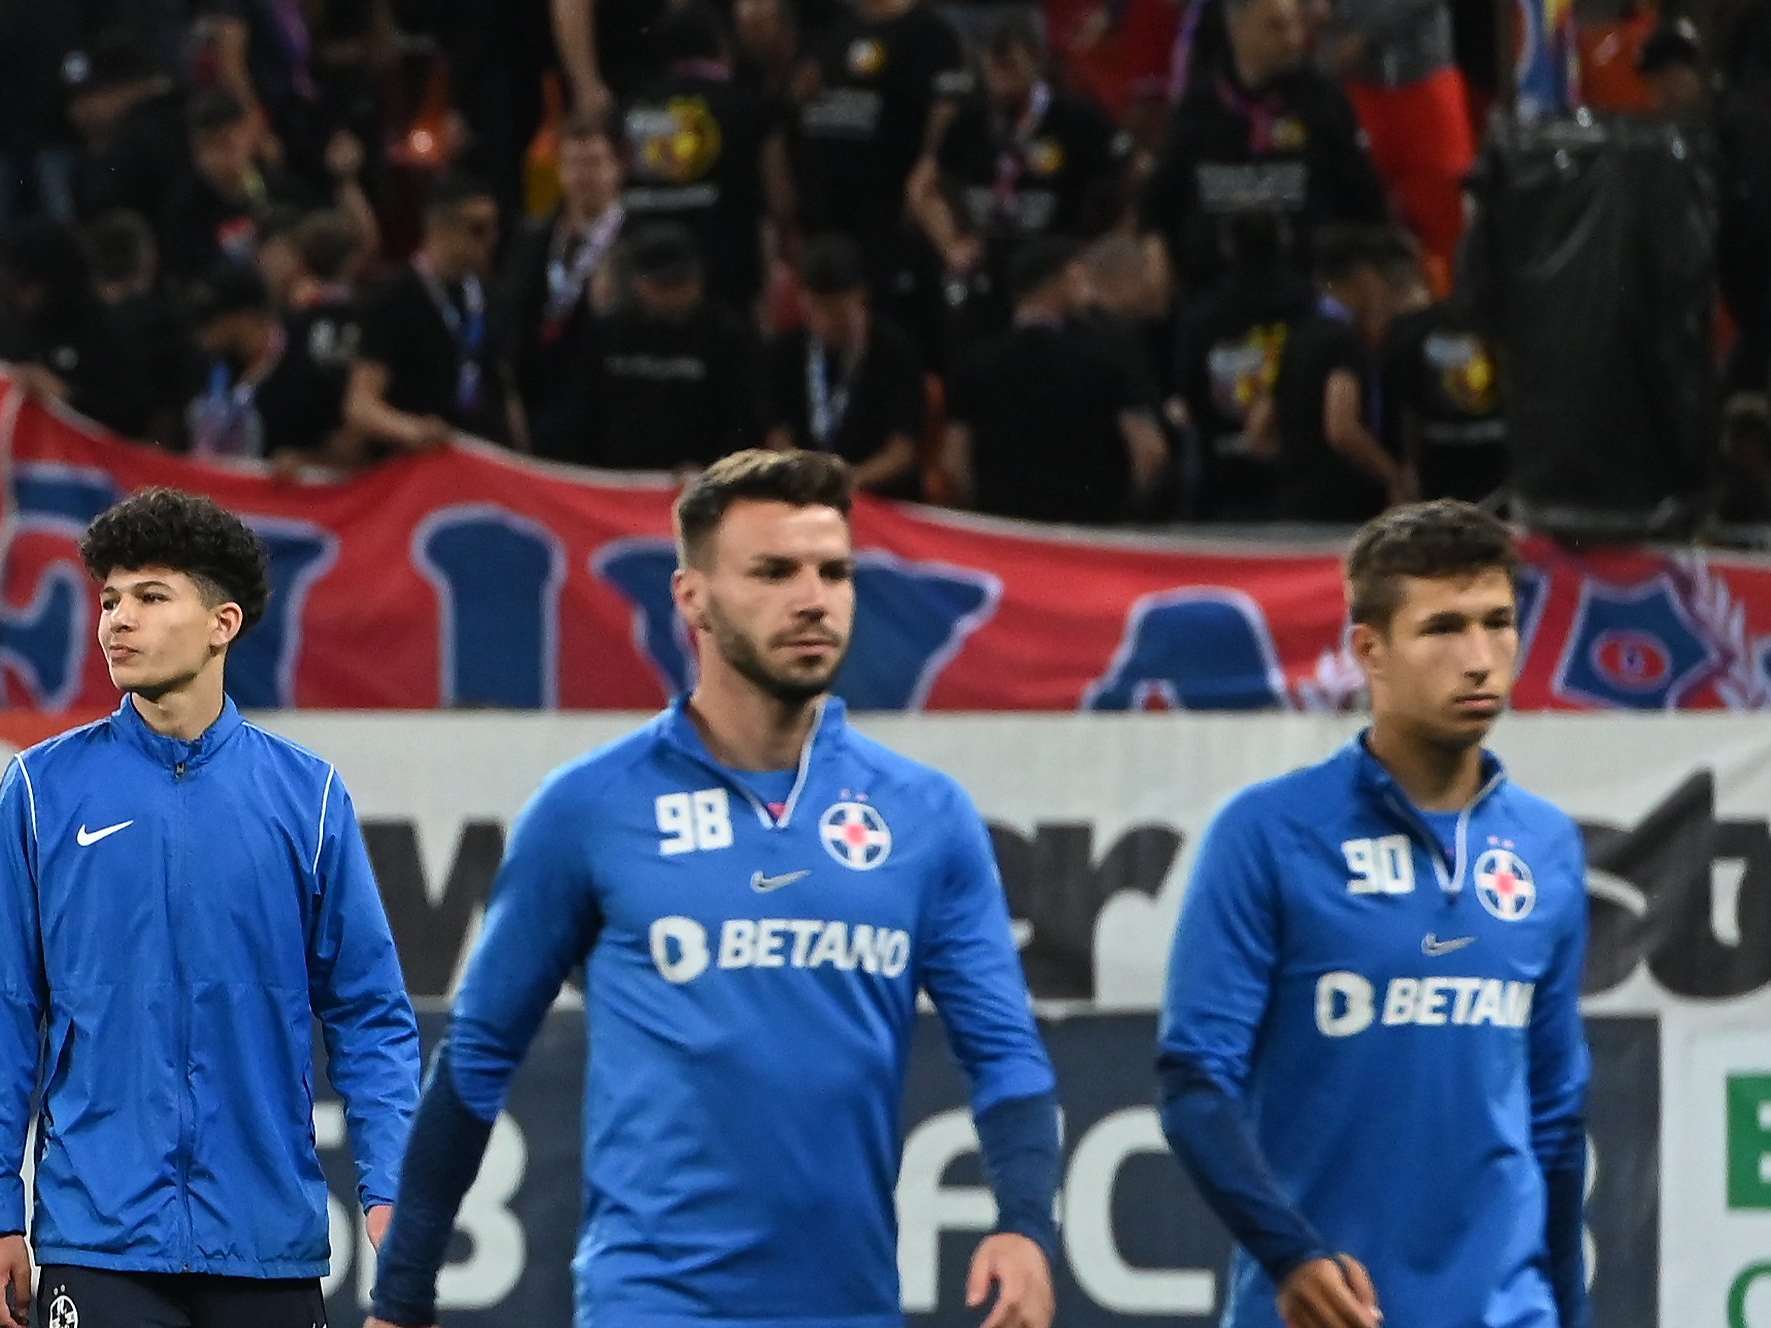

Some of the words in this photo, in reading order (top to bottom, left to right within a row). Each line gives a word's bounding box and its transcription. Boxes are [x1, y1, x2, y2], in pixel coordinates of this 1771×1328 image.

[654, 787, 734, 857] 98
[1341, 833, 1416, 894] 90
[717, 918, 911, 979] BETANO
[1381, 976, 1536, 1028] BETAN
